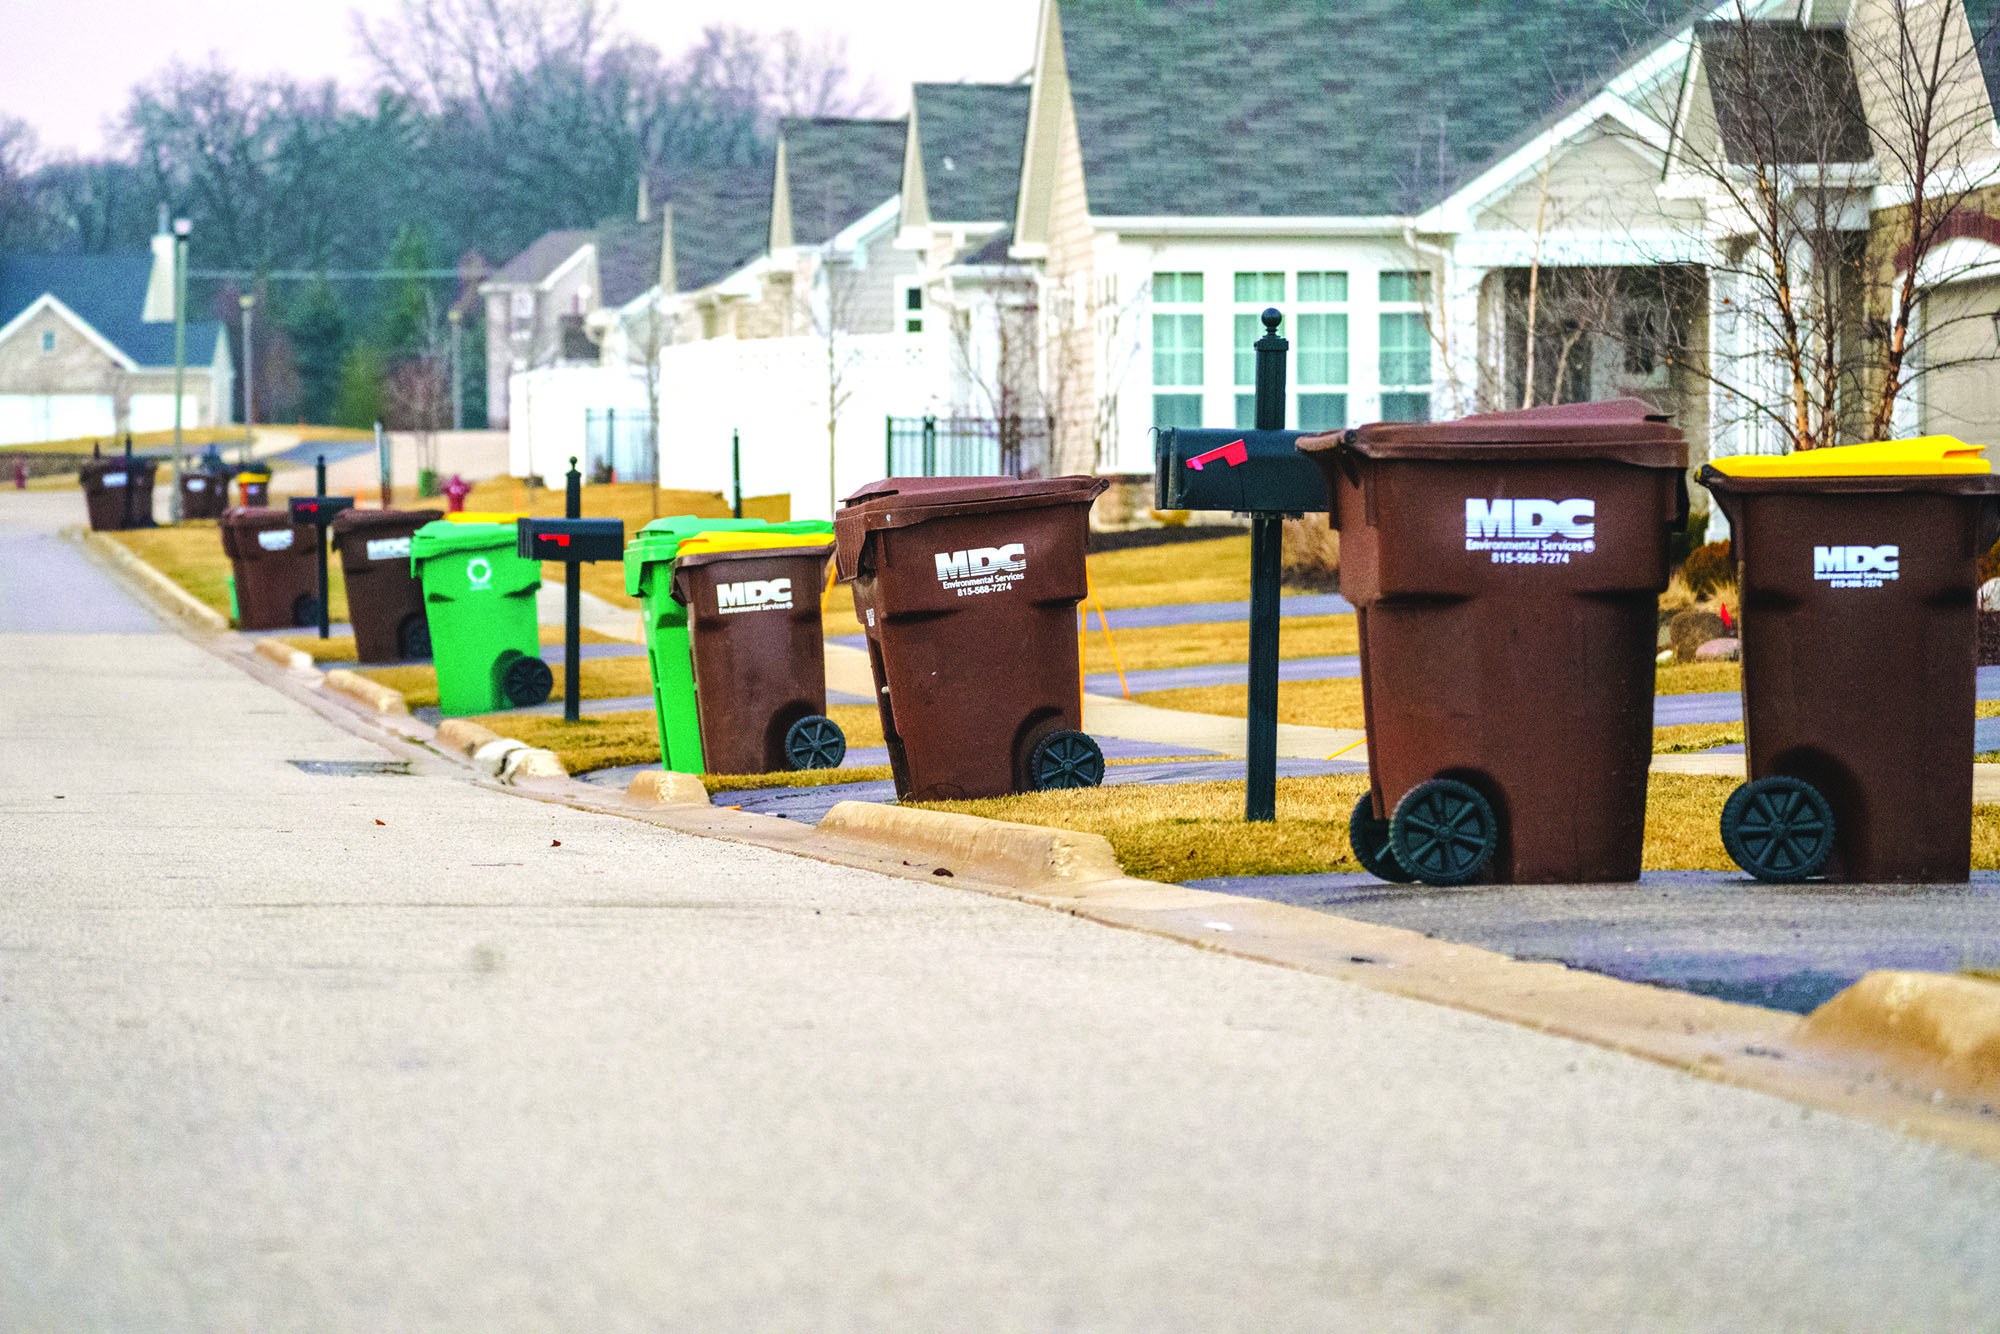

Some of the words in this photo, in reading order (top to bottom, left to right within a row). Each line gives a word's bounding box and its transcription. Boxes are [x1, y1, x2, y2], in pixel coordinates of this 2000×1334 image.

[1465, 498, 1595, 539] MDC
[1465, 538, 1540, 551] Environmental
[1541, 540, 1583, 552] Services
[1491, 551, 1570, 564] 815-568-7274
[1814, 545, 1899, 572] MDC
[935, 543, 1027, 581] MDC
[716, 578, 792, 607] MDC
[942, 576, 994, 590] Environmental
[995, 572, 1025, 583] Services
